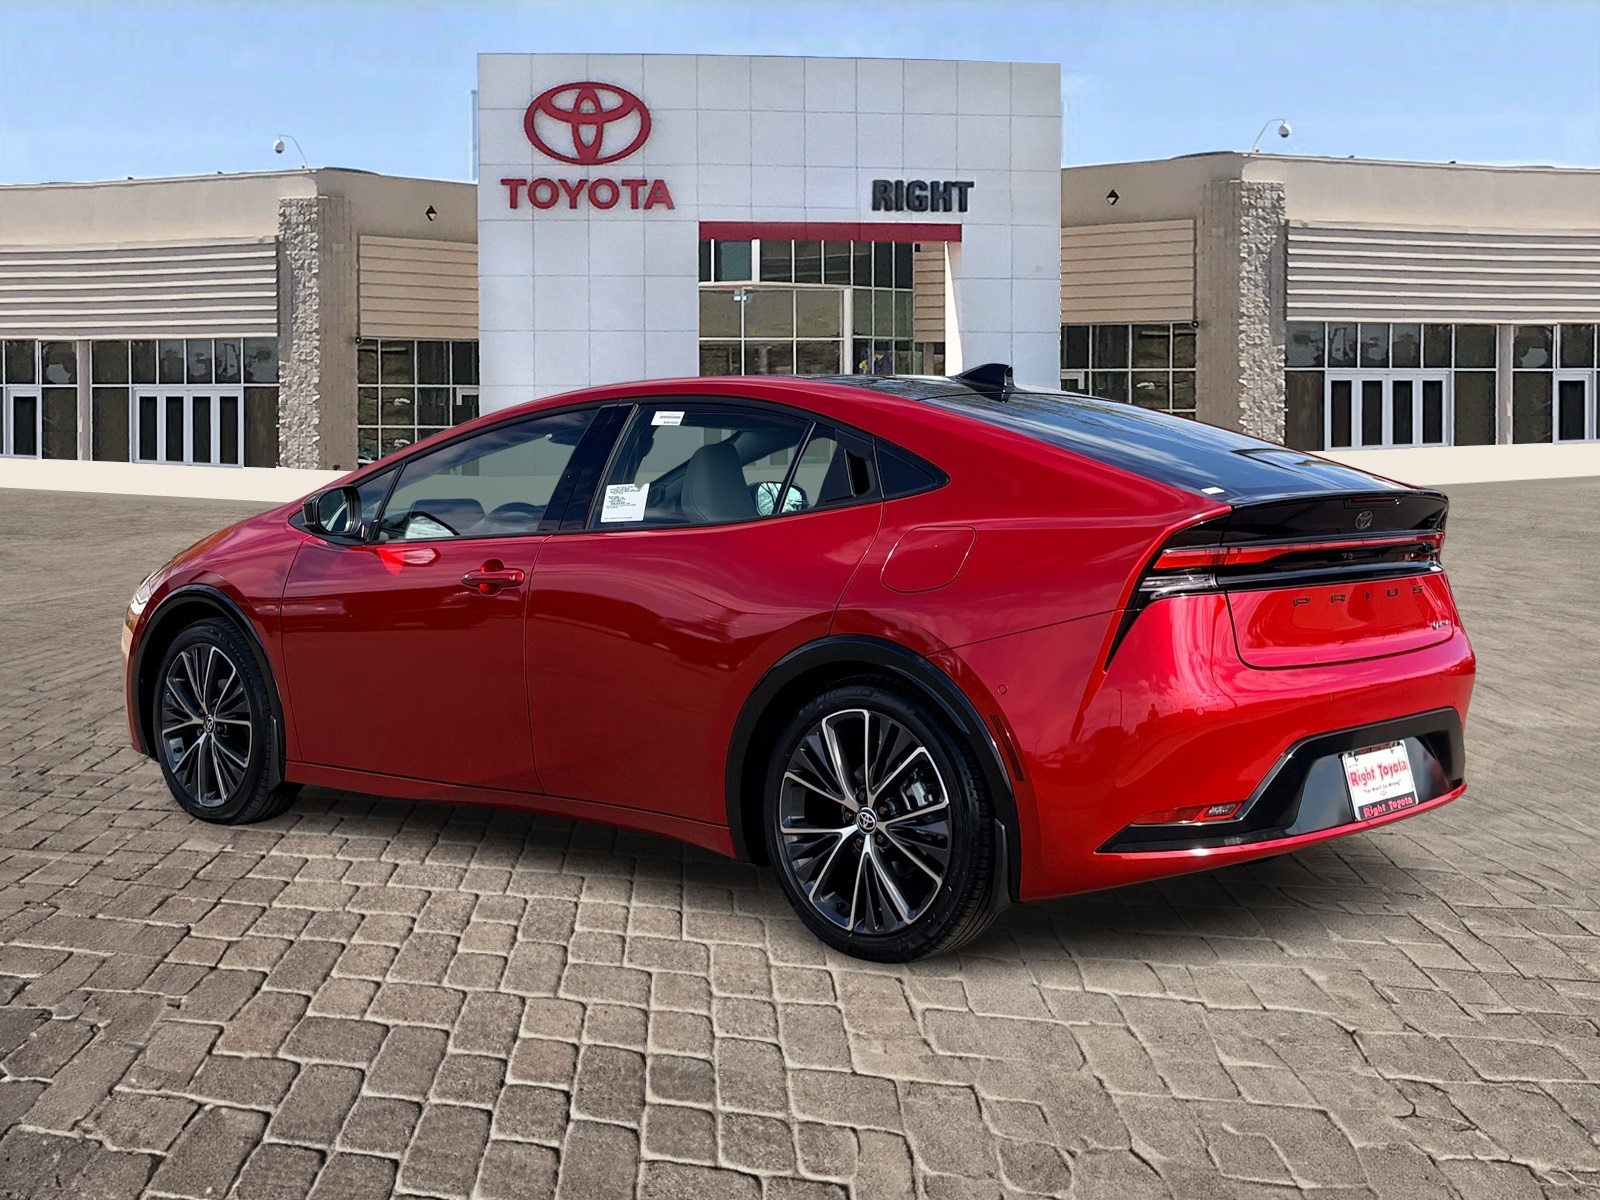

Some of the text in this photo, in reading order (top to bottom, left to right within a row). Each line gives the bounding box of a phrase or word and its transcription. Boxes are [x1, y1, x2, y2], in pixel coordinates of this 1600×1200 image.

[500, 177, 675, 210] TOYOTA
[872, 179, 975, 212] RIGHT
[1293, 585, 1424, 607] PRIUS
[1349, 760, 1408, 787] Right Toyota
[1363, 796, 1413, 818] Right Toyota
